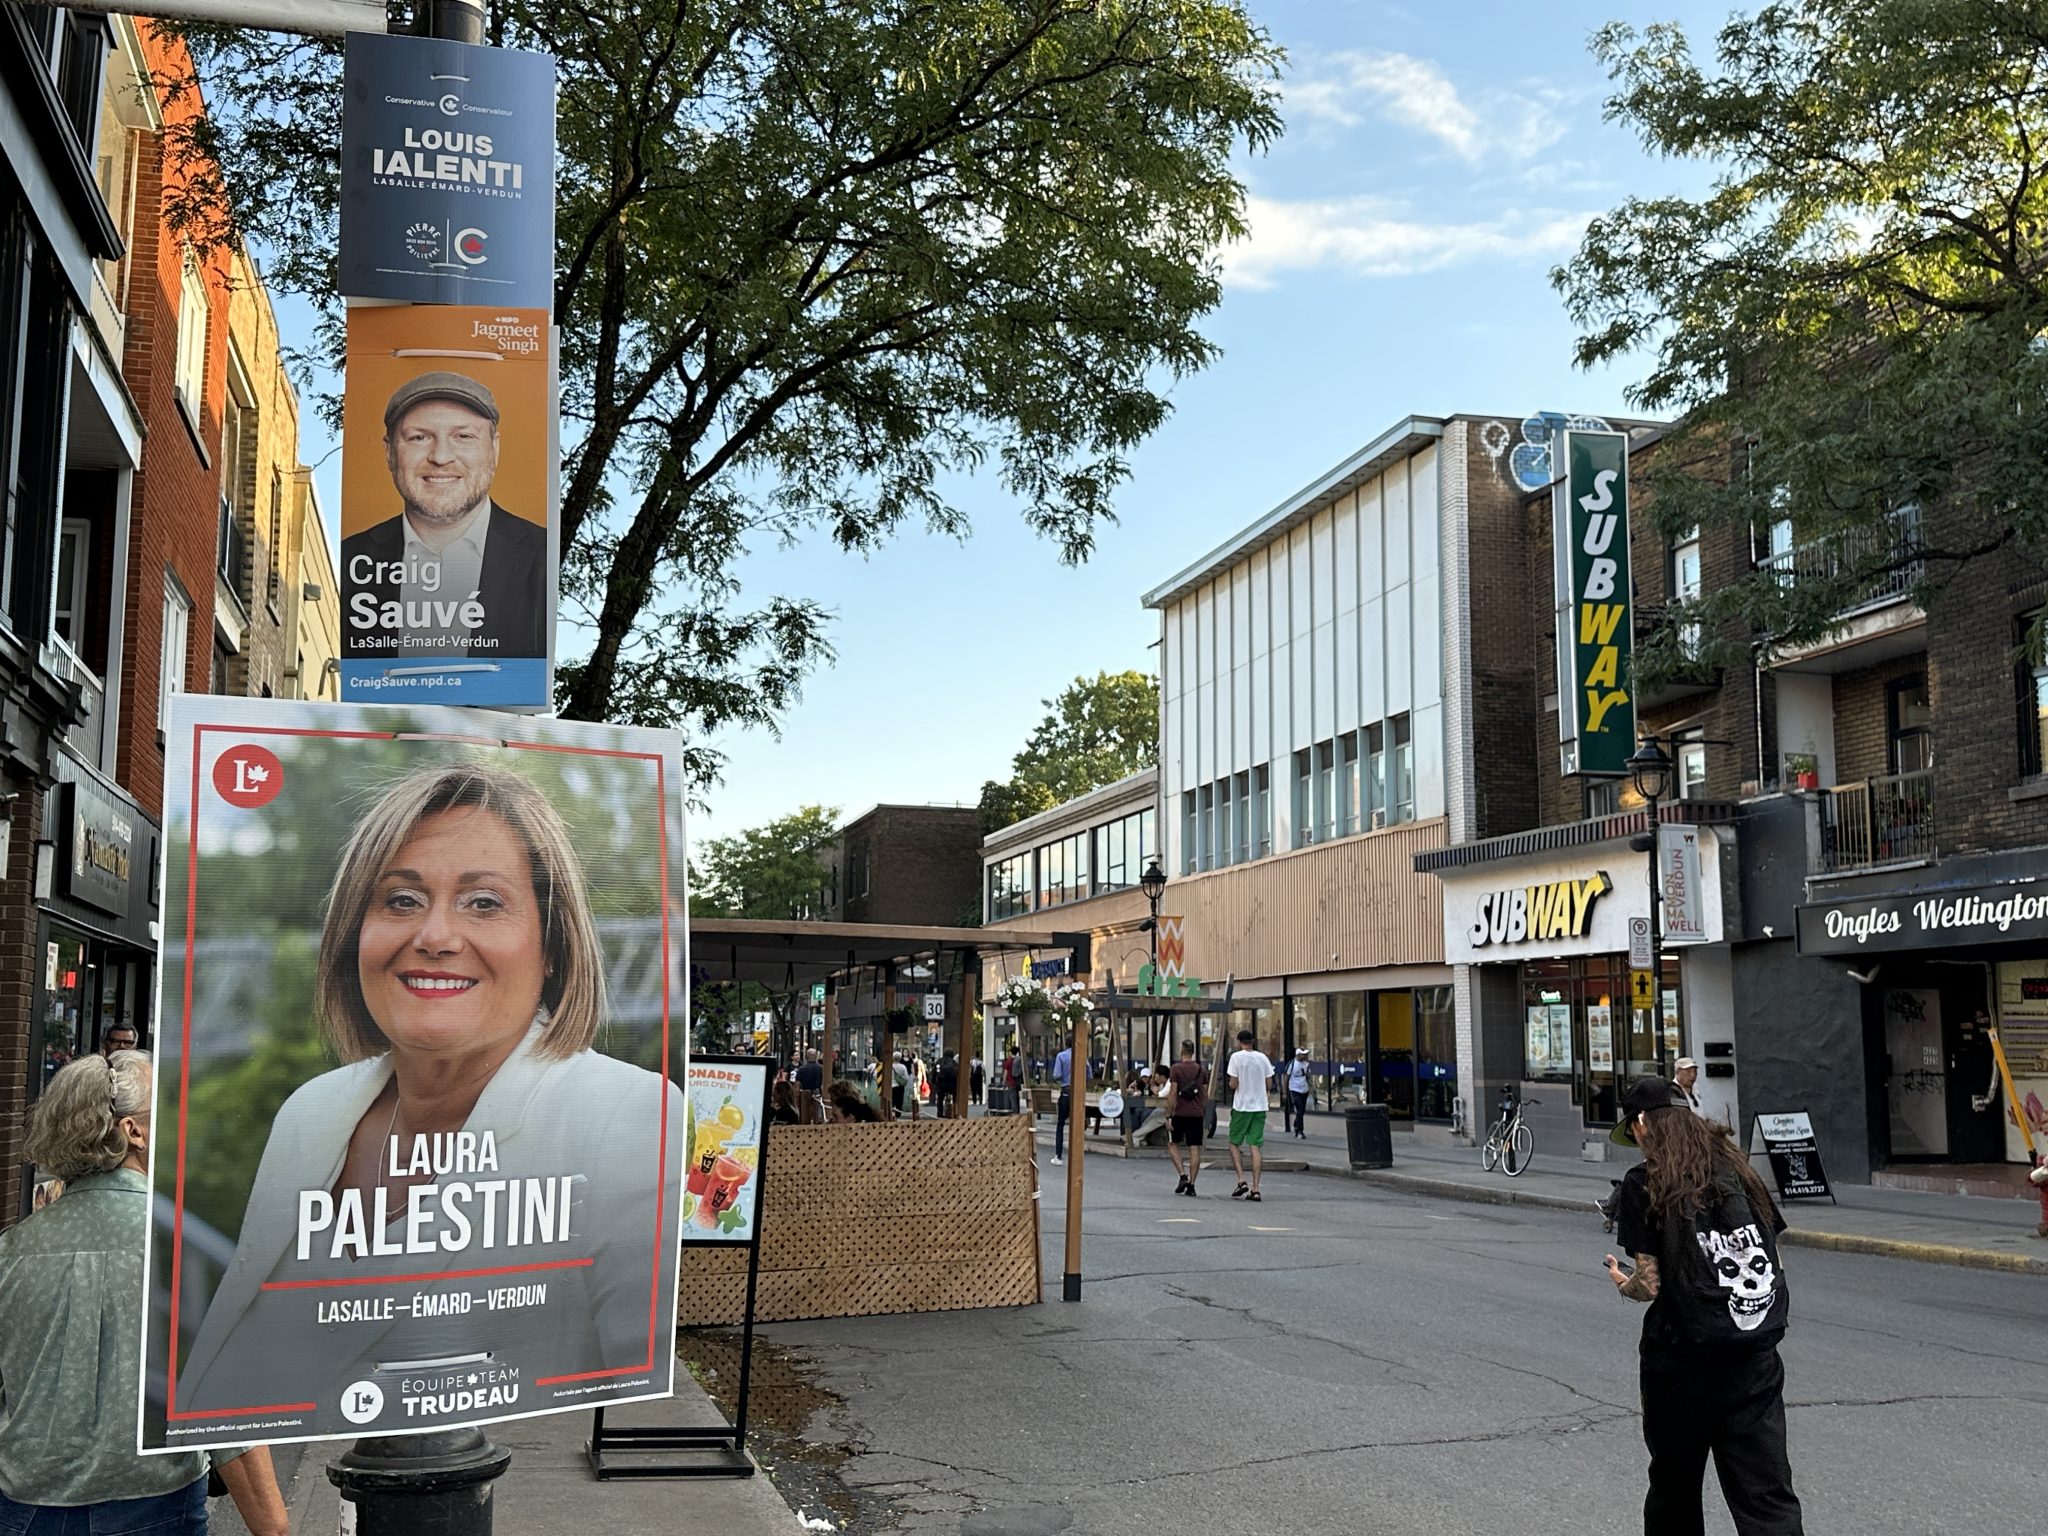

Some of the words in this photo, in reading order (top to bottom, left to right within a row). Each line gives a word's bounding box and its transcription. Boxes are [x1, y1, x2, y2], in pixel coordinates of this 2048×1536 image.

[385, 95, 435, 107] Conservative
[462, 104, 513, 116] Conservateur
[404, 127, 494, 157] LOUIS
[373, 148, 522, 190] IALENTI
[373, 177, 522, 199] LASALLE-ÉMARD-VERDUN
[406, 222, 441, 239] PIERRE
[470, 320, 539, 340] Jagmeet
[497, 337, 539, 355] Singh
[349, 553, 442, 592] Craig
[349, 590, 486, 630] Sauvé
[1578, 468, 1631, 732] SUBWAY
[350, 633, 500, 649] LaSalle-Émard-Verdun
[350, 675, 462, 690] CraigSauve.npd.ca
[1673, 848, 1686, 908] VERDUN
[1468, 872, 1612, 948] SUBWAY
[1825, 907, 1902, 944] Ongles
[1913, 892, 2048, 932] Wellington
[1667, 920, 1701, 931] WELL
[1138, 963, 1202, 996] fizz
[927, 1002, 943, 1016] 30
[389, 1130, 499, 1177] LAURA
[296, 1175, 573, 1261] PALESTINI
[402, 1375, 465, 1394] ÉQUIPE
[479, 1367, 520, 1385] TEAM
[401, 1383, 519, 1417] TRUDEAU
[165, 1427, 198, 1436] Authorized
[197, 1426, 206, 1434] by
[206, 1425, 216, 1433] the
[216, 1423, 236, 1432] official
[236, 1422, 252, 1431] agent
[252, 1421, 261, 1429] for
[261, 1420, 277, 1429] Laura
[277, 1418, 303, 1427] Palestini.
